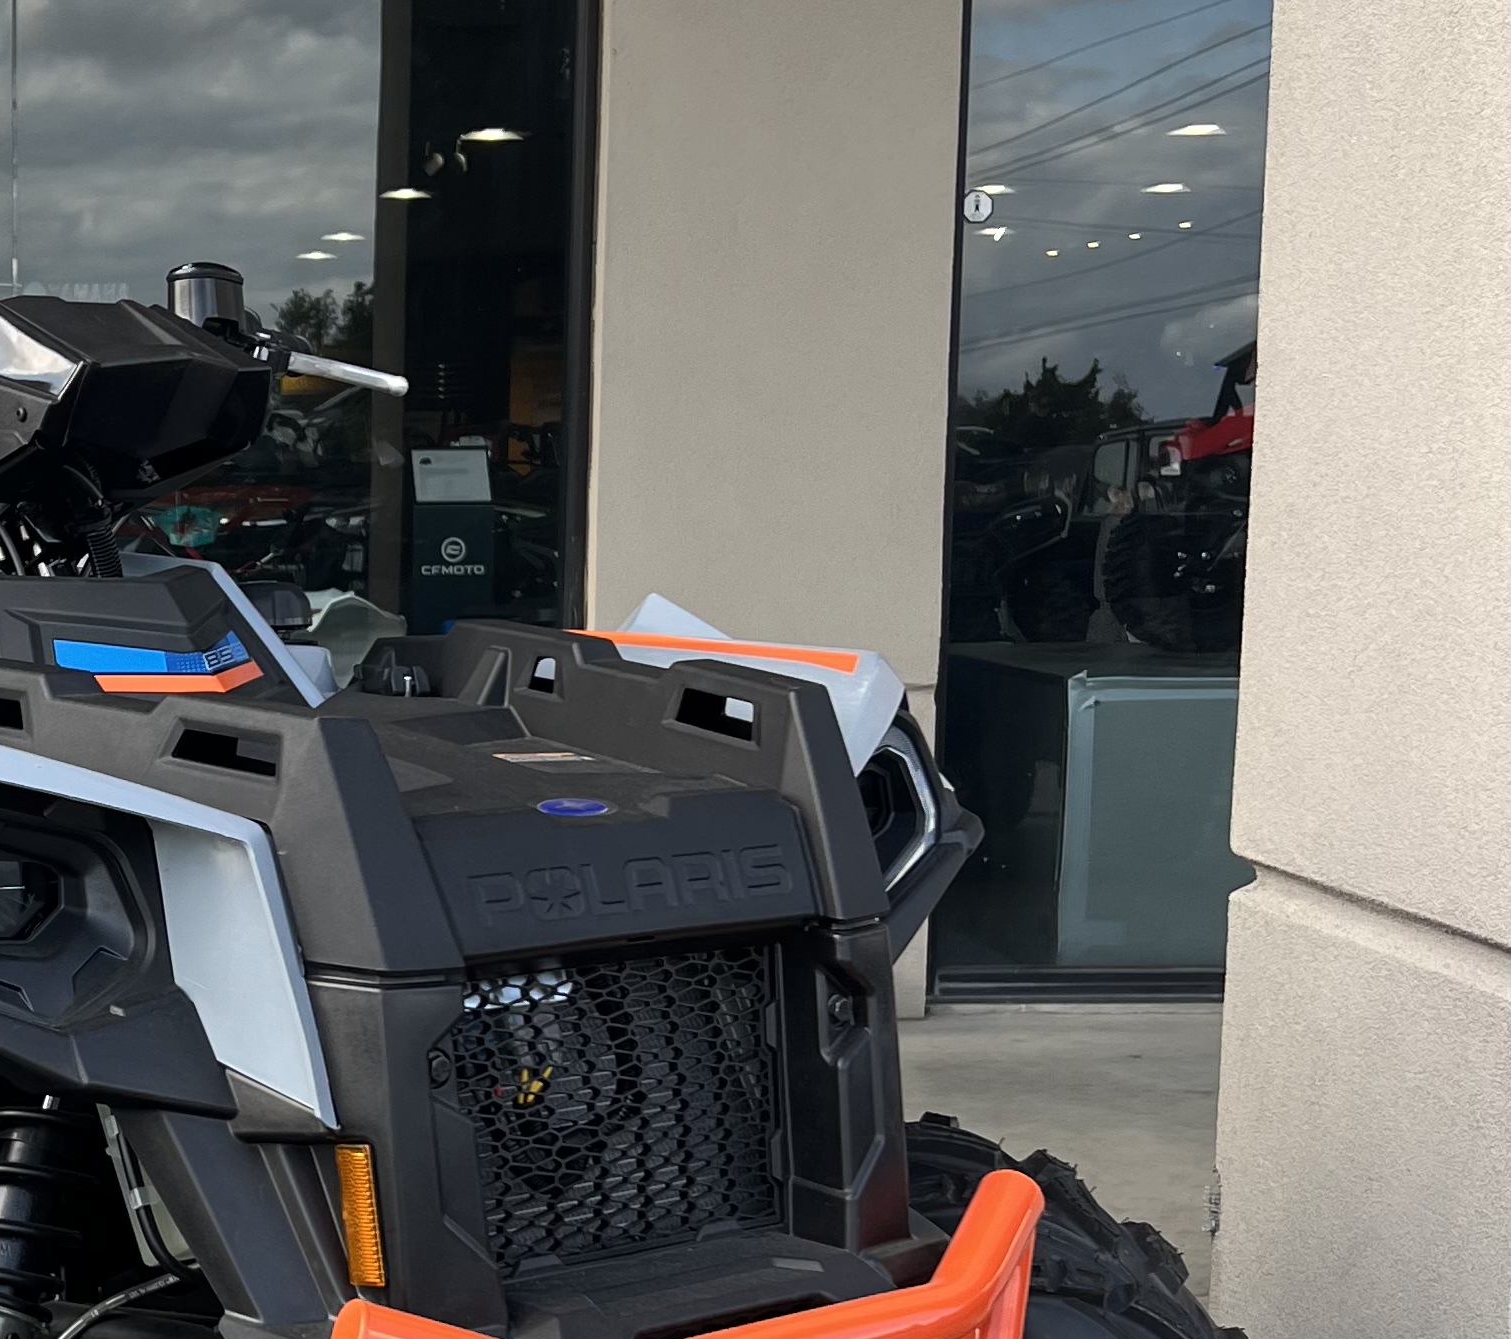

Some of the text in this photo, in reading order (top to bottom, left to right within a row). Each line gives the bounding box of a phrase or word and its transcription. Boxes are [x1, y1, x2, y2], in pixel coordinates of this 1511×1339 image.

[420, 564, 486, 576] CFMOTO
[203, 642, 249, 671] 850
[466, 843, 794, 928] POLARIS
